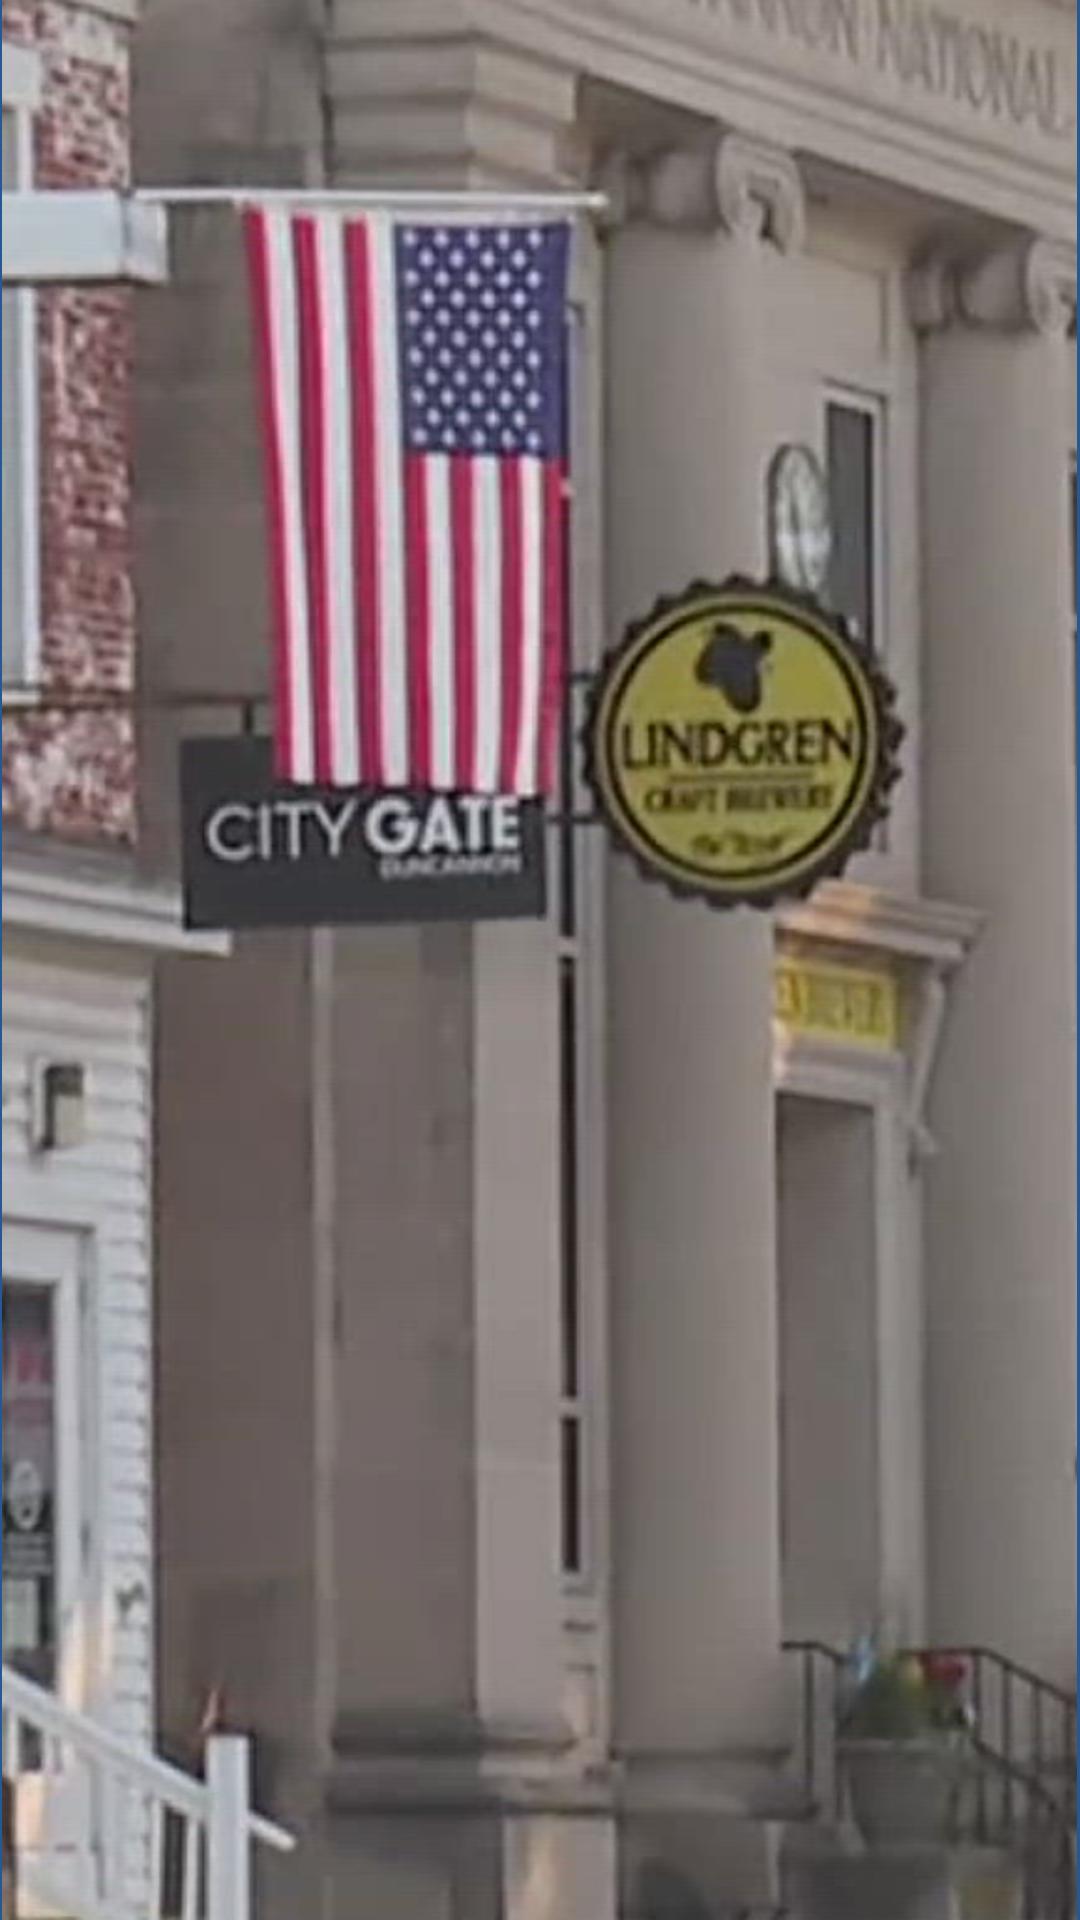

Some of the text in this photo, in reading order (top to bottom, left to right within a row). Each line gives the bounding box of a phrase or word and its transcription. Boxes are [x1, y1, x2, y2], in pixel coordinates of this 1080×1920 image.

[622, 719, 853, 769] LINDGREN
[207, 794, 521, 861] CITY GATE
